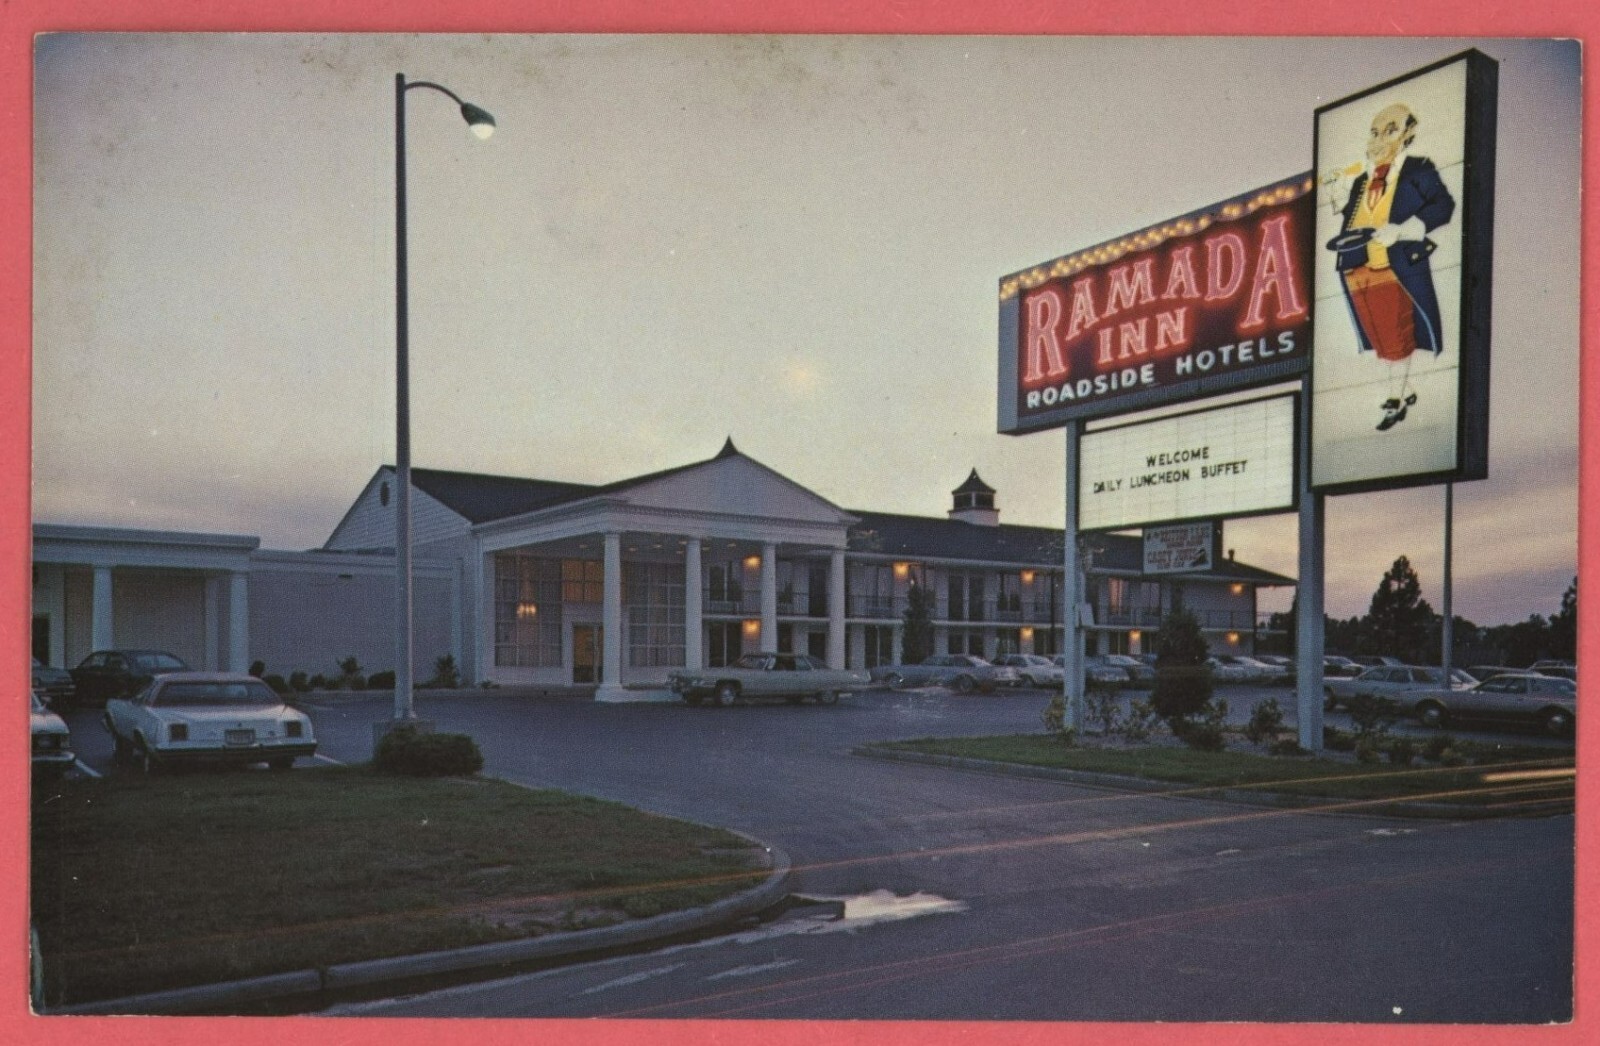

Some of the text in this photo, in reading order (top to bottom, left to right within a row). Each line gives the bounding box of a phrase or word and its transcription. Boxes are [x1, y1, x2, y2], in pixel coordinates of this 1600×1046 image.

[1023, 211, 1305, 382] RAMADA
[1097, 307, 1188, 365] INN
[1026, 331, 1295, 409] ROADSIDE HOTELS
[1093, 459, 1248, 494] DAILY LUNCHEON BUFFET
[1146, 446, 1210, 467] WELCOME
